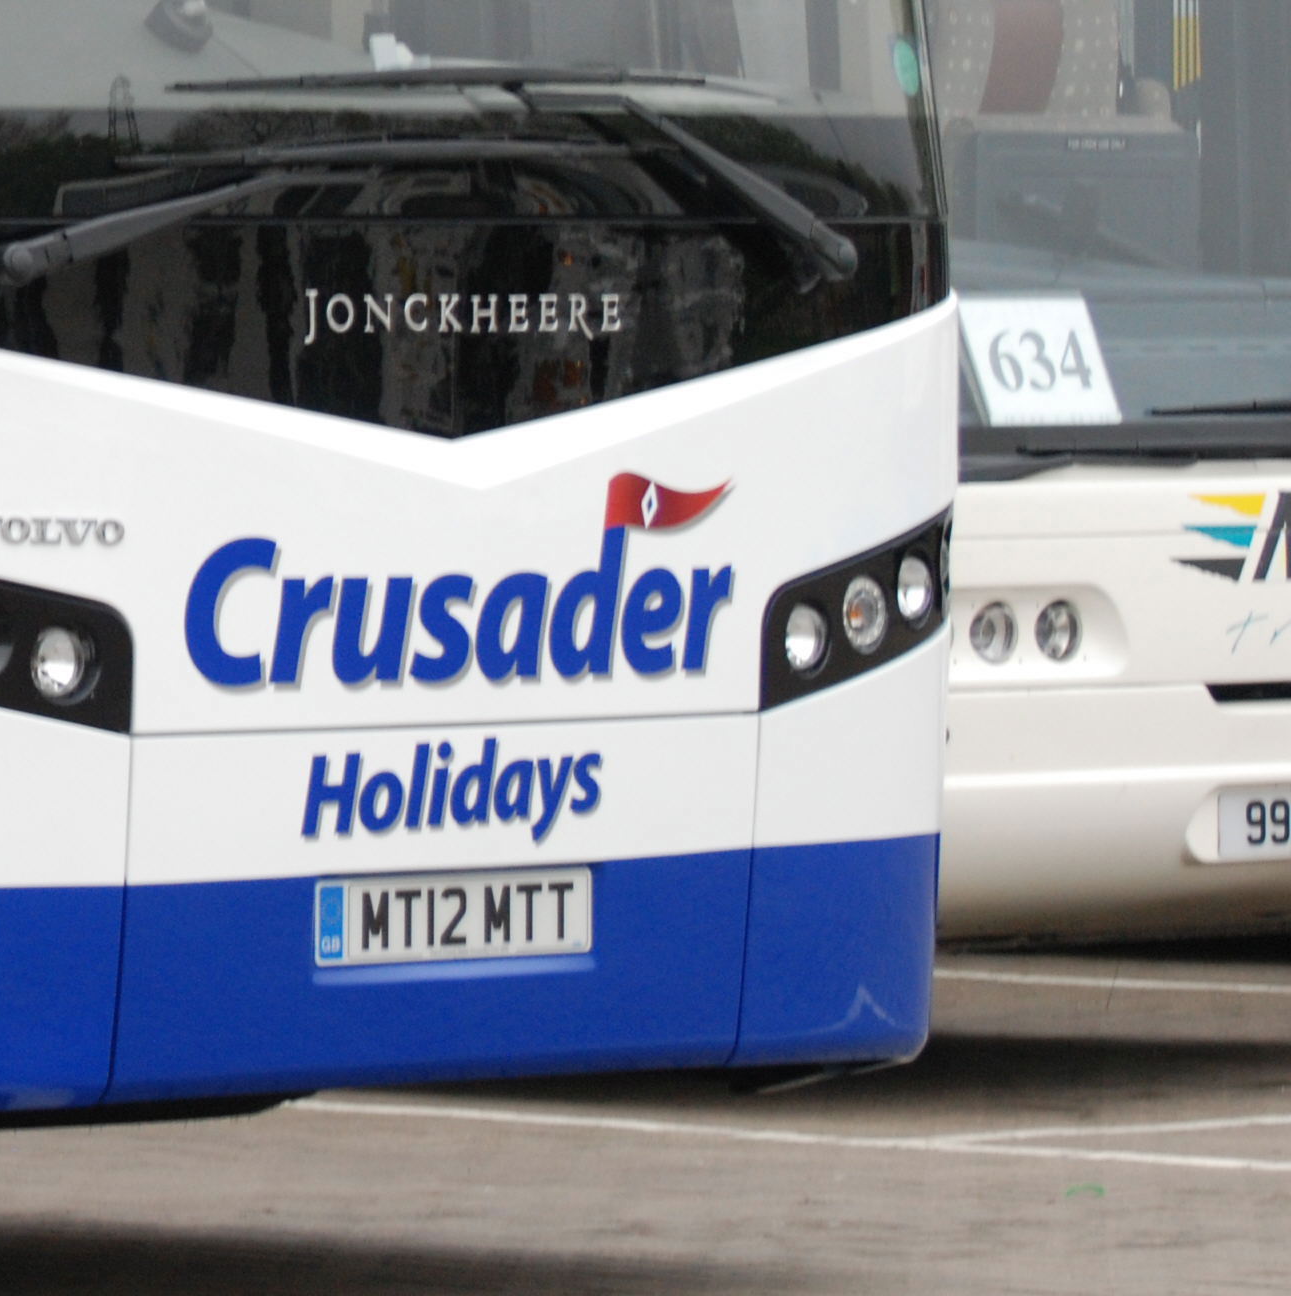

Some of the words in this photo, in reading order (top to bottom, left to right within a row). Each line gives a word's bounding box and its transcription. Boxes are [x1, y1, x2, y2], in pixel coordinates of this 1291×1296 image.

[304, 287, 622, 345] JONCKHEERE
[989, 329, 1092, 393] 634
[185, 526, 735, 688] Crusader
[301, 738, 603, 842] Holidays
[321, 935, 341, 954] GB
[362, 887, 467, 950] MT12
[484, 882, 574, 944] MTT
